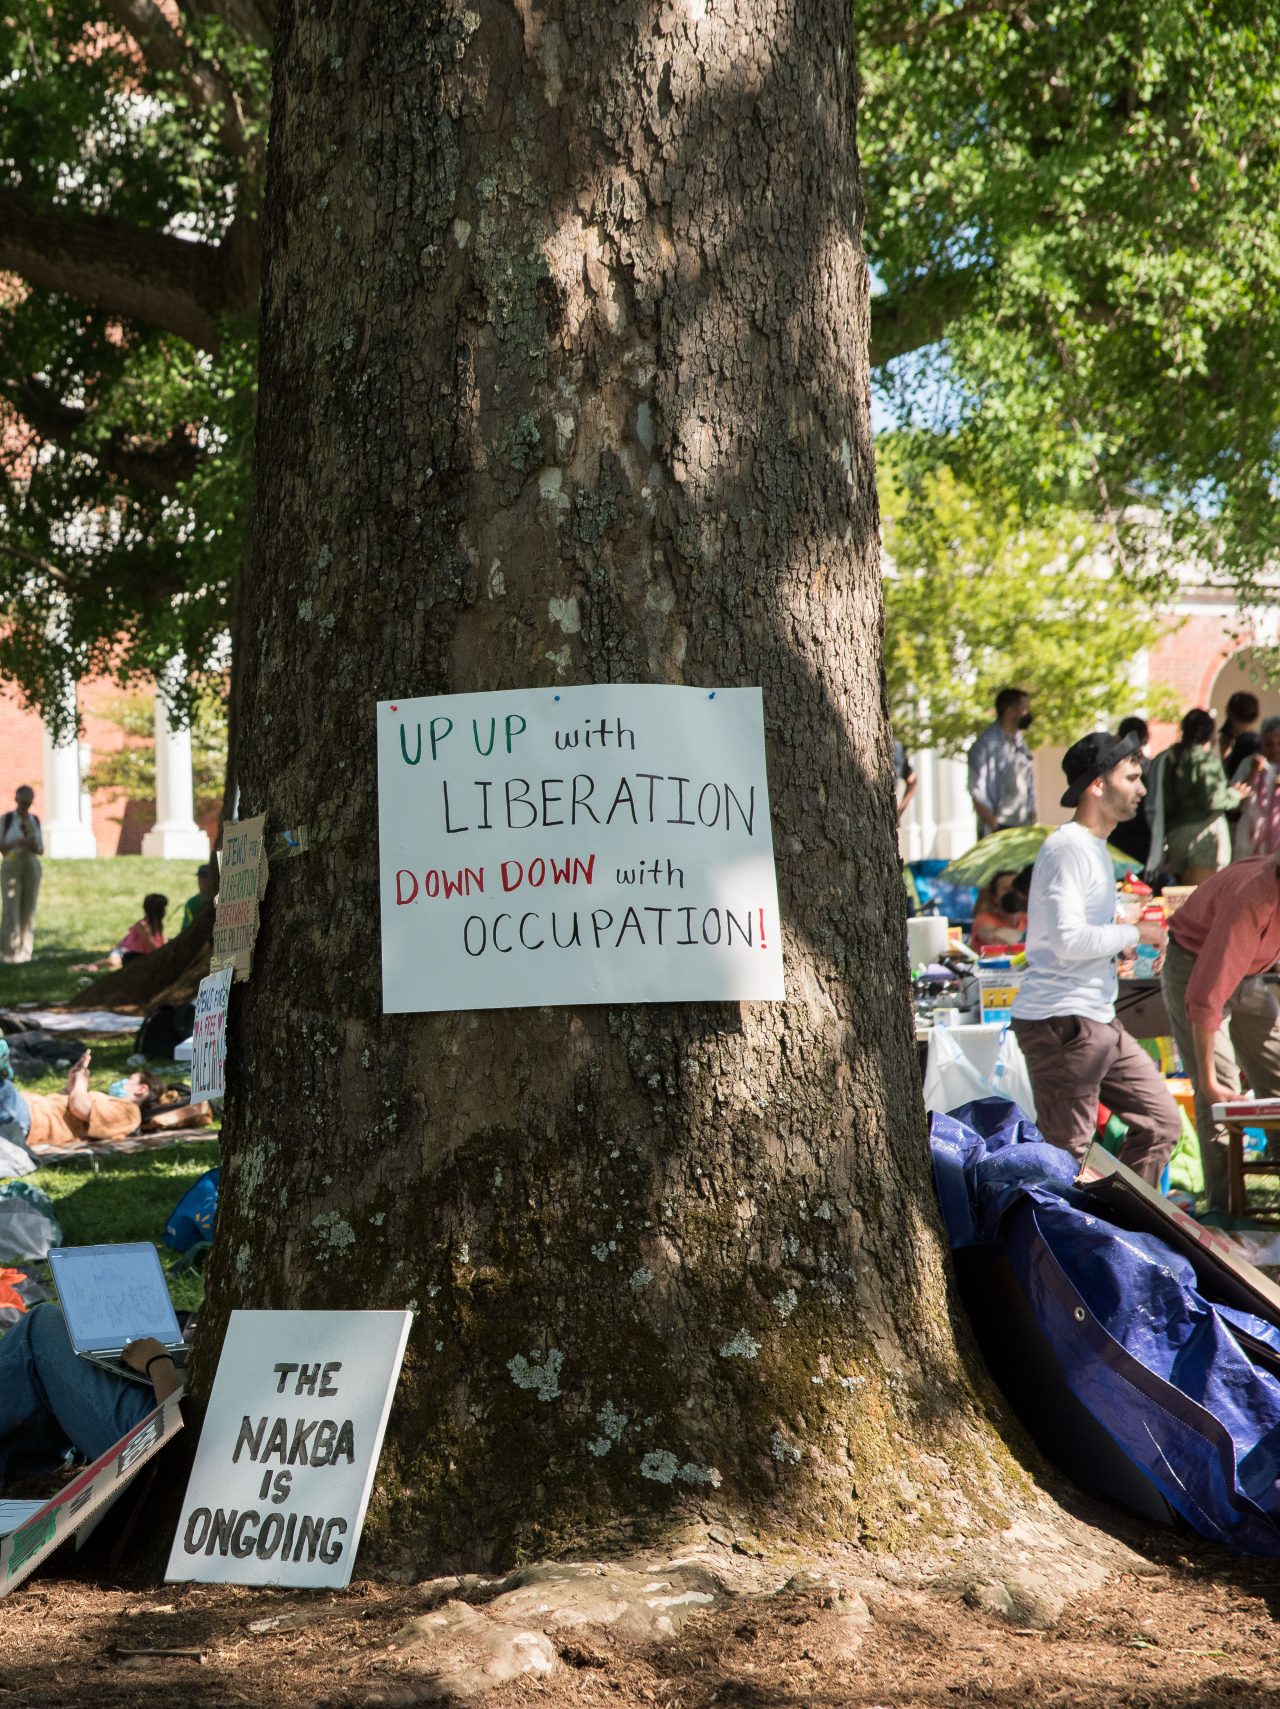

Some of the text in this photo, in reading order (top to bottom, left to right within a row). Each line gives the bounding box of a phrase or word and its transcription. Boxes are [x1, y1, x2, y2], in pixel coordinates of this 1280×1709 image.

[399, 714, 636, 765] UP UP with
[442, 773, 755, 837] LIBERATION
[225, 833, 248, 866] JEWS
[220, 867, 258, 903] LIBERATION
[396, 854, 685, 906] DOWN DOWN with
[213, 929, 227, 954] FREE
[463, 905, 768, 957] OCCUPATION!
[197, 987, 214, 1013] JEWS
[204, 1013, 217, 1038] FREE
[273, 1361, 343, 1398] THE
[231, 1415, 356, 1468] NAKBA
[258, 1469, 293, 1505] IS
[183, 1506, 348, 1566] ONGOING
